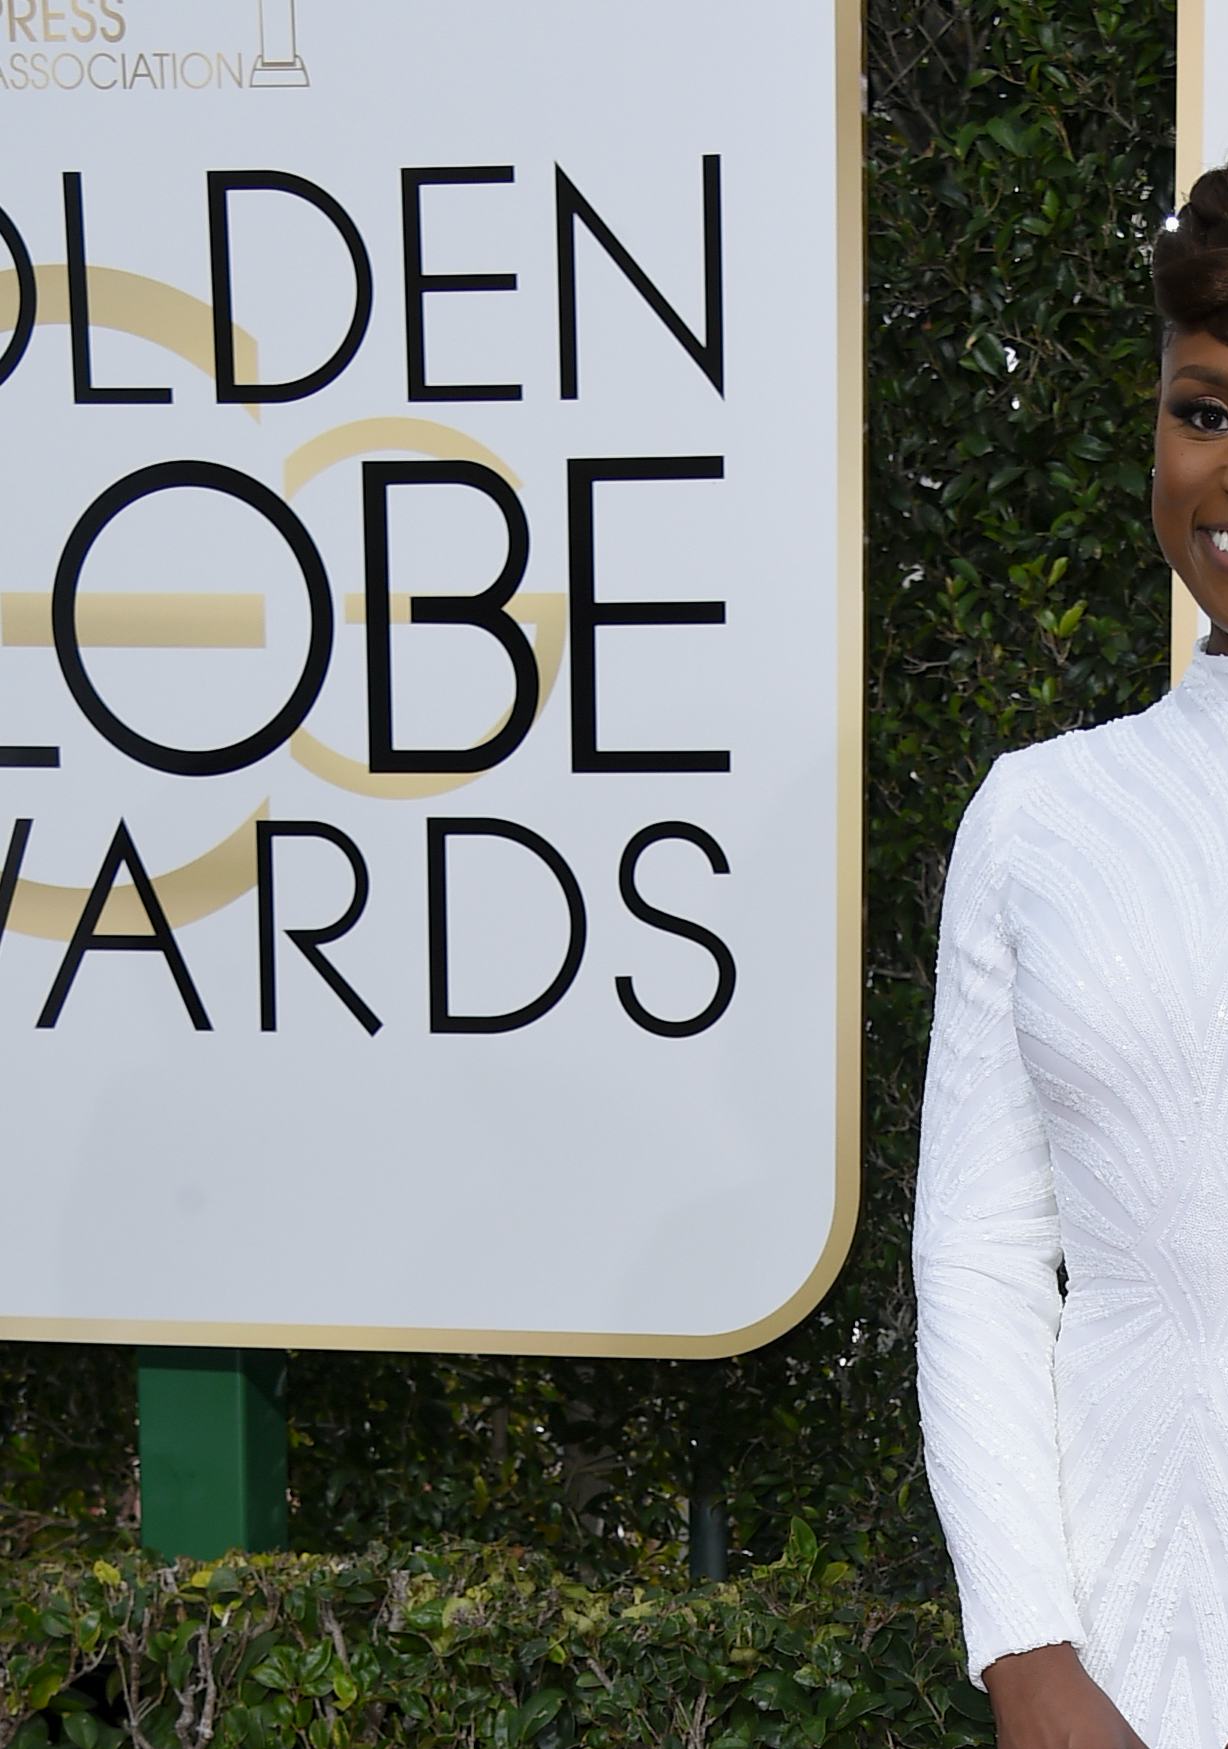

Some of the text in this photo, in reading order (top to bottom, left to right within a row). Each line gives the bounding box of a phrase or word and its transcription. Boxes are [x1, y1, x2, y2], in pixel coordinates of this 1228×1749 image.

[0, 0, 126, 43] RESS
[0, 155, 723, 404] LDEN
[0, 818, 737, 1038] ARDS
